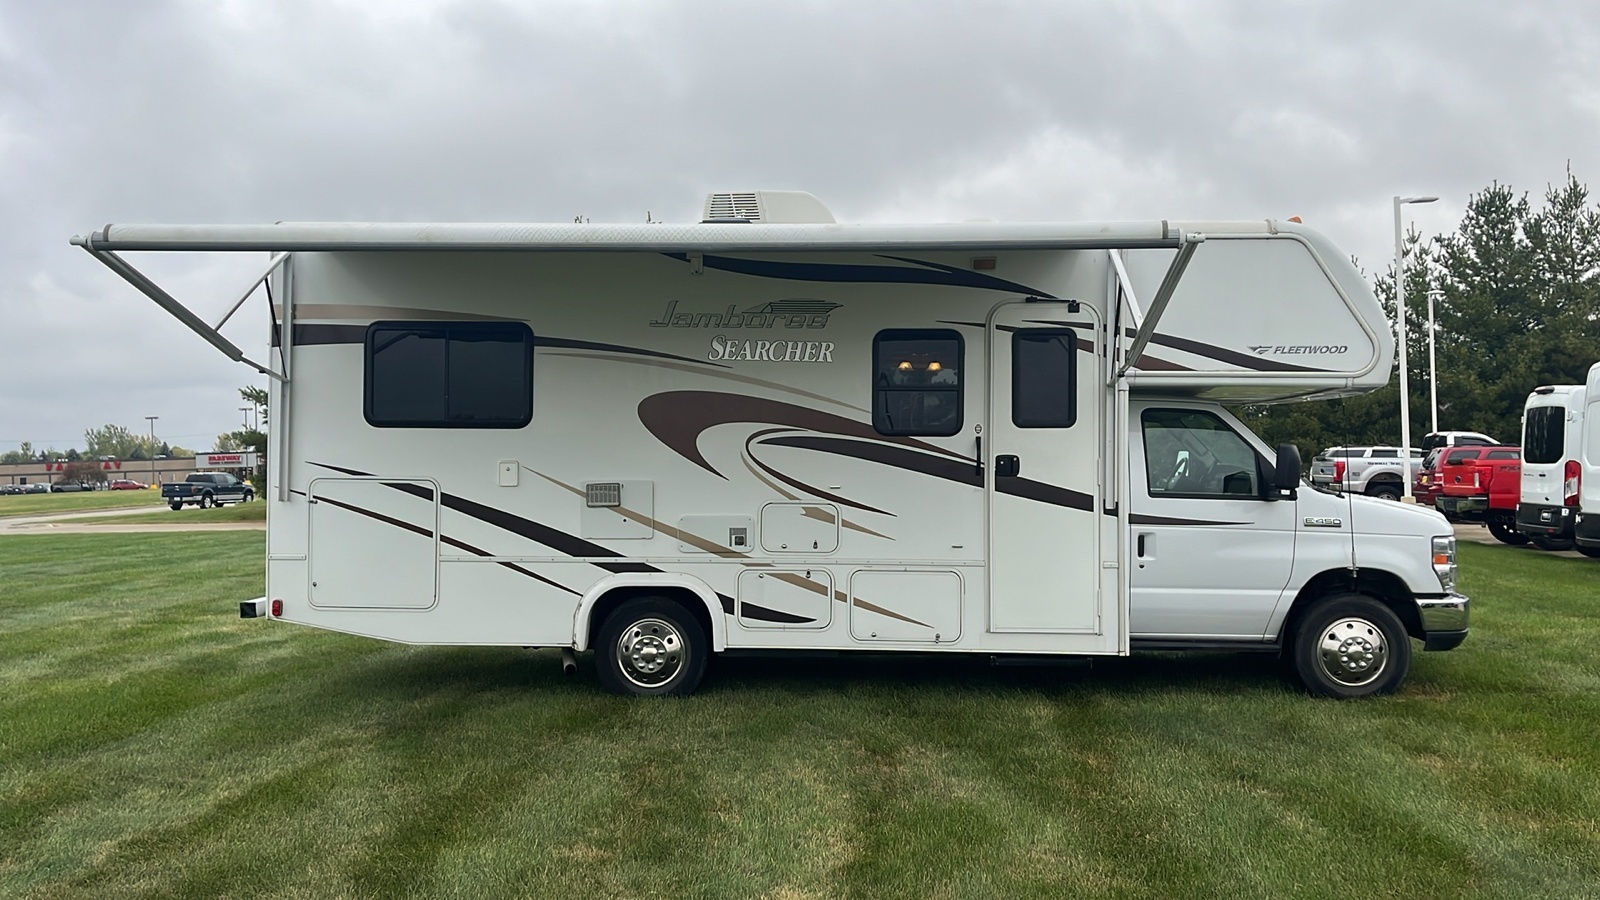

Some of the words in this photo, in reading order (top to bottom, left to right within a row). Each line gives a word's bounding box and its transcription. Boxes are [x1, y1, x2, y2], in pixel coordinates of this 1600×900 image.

[649, 300, 831, 328] Jamboree
[708, 334, 835, 362] SEARCHER
[1273, 345, 1349, 354] FLEETWOOD
